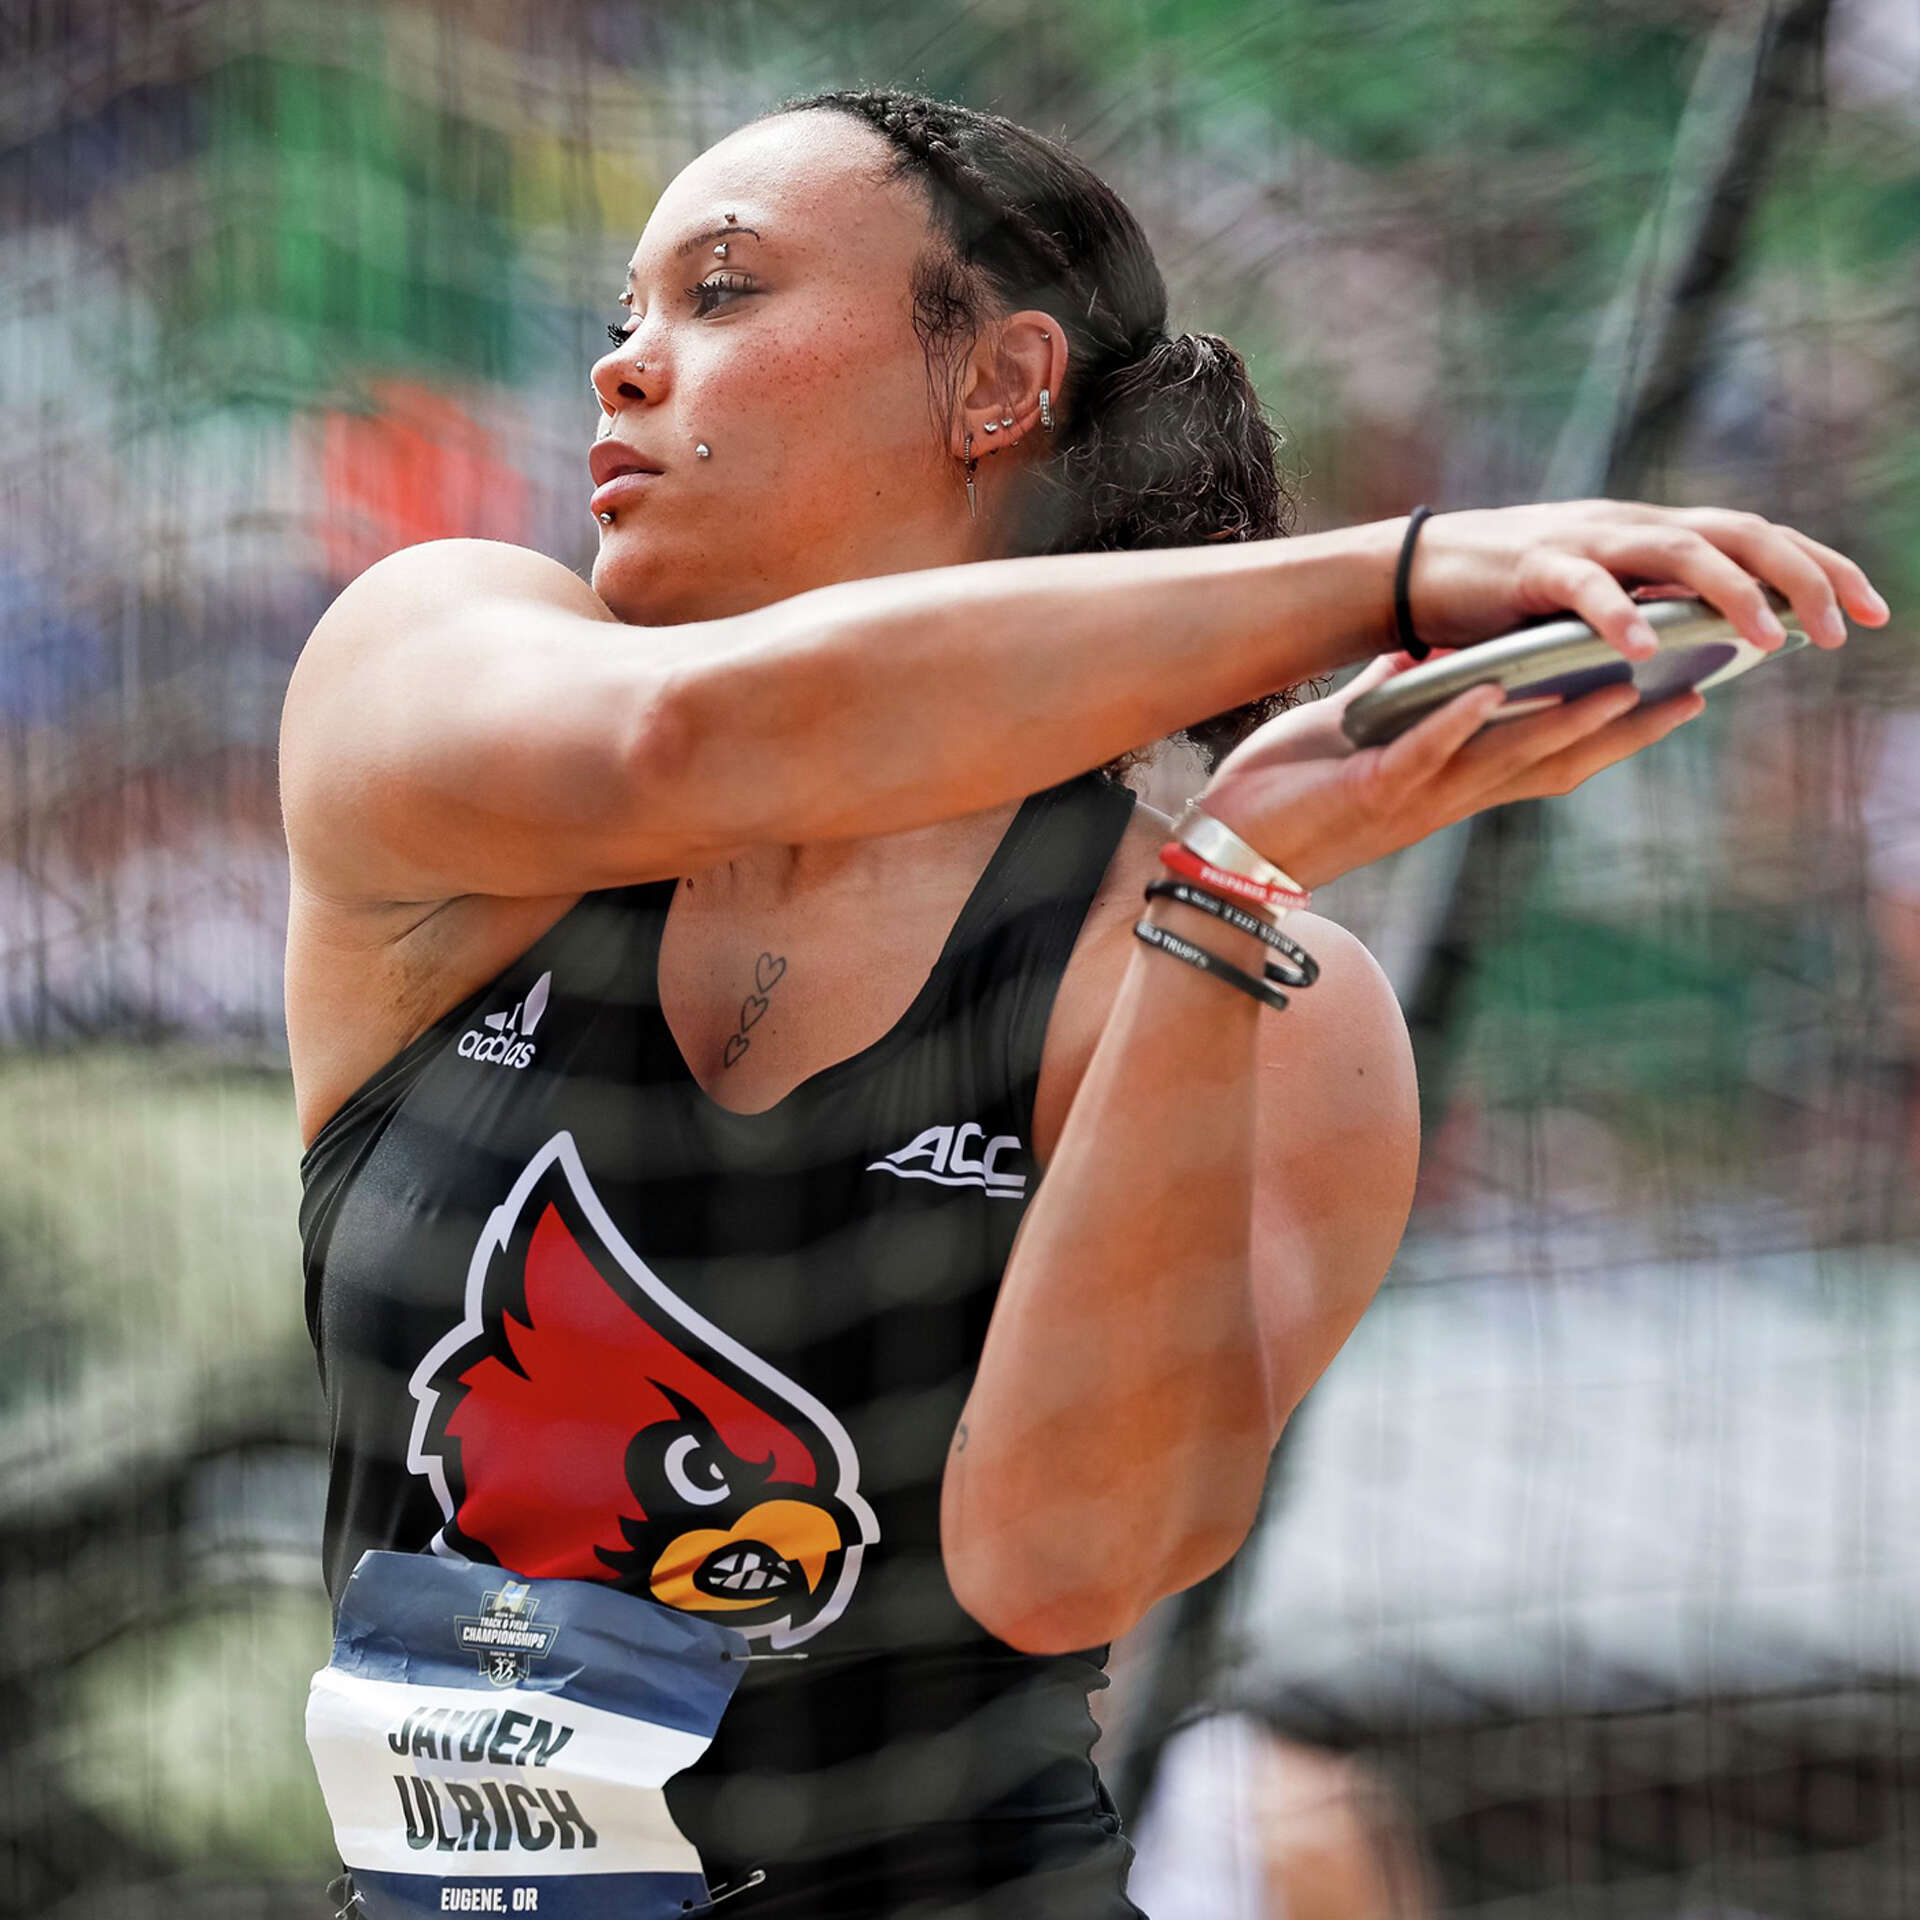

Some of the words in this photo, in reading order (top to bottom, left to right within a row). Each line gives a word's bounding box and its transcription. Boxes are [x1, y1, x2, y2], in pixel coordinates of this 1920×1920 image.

[457, 1029, 536, 1069] addas
[885, 1122, 1027, 1187] ACC
[462, 1626, 547, 1649] CHAMPIONSHIPS
[388, 1706, 574, 1767] JAYDEN
[393, 1775, 598, 1852] ULRICH
[441, 1887, 508, 1914] EUGENE,
[512, 1887, 538, 1911] OR
